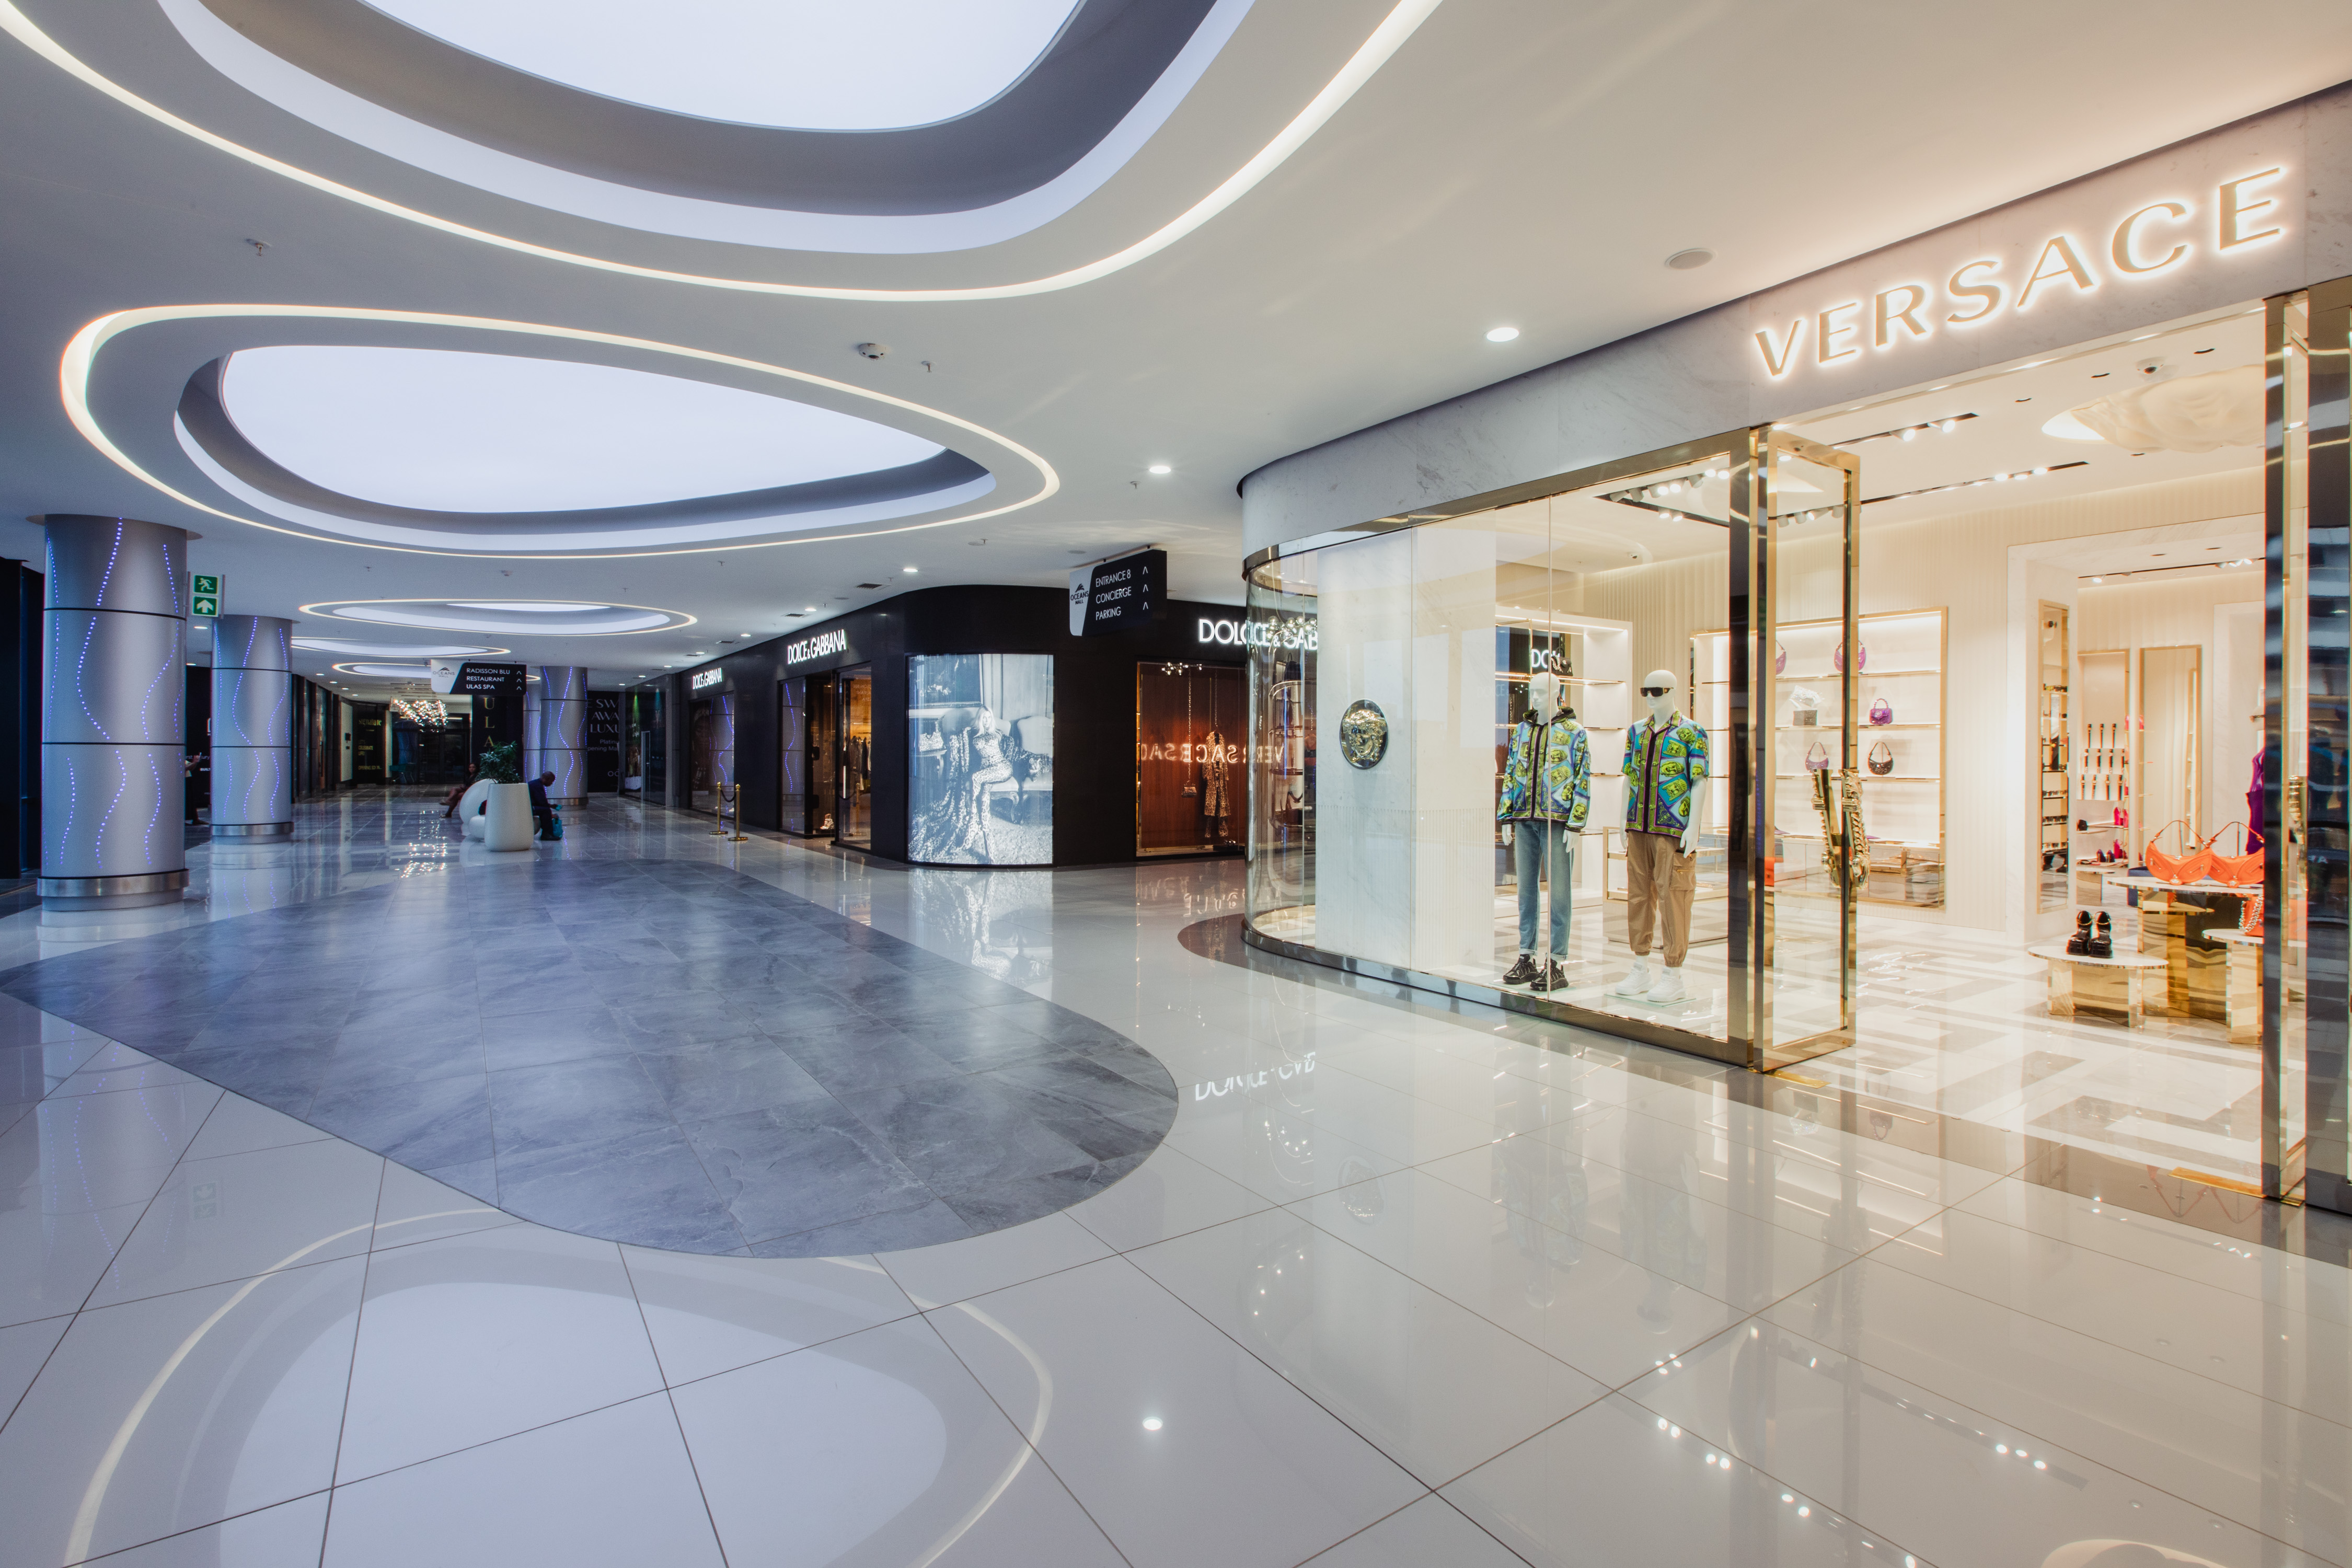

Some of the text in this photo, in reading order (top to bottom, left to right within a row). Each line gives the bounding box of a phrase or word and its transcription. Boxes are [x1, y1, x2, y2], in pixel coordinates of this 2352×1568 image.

[1755, 167, 2282, 377] VERSACE
[1096, 569, 1131, 587] ENTRANCE 8
[1070, 591, 1089, 601] OCEANS
[1096, 586, 1132, 604] CONCIERGE
[1096, 606, 1121, 621] PARKING
